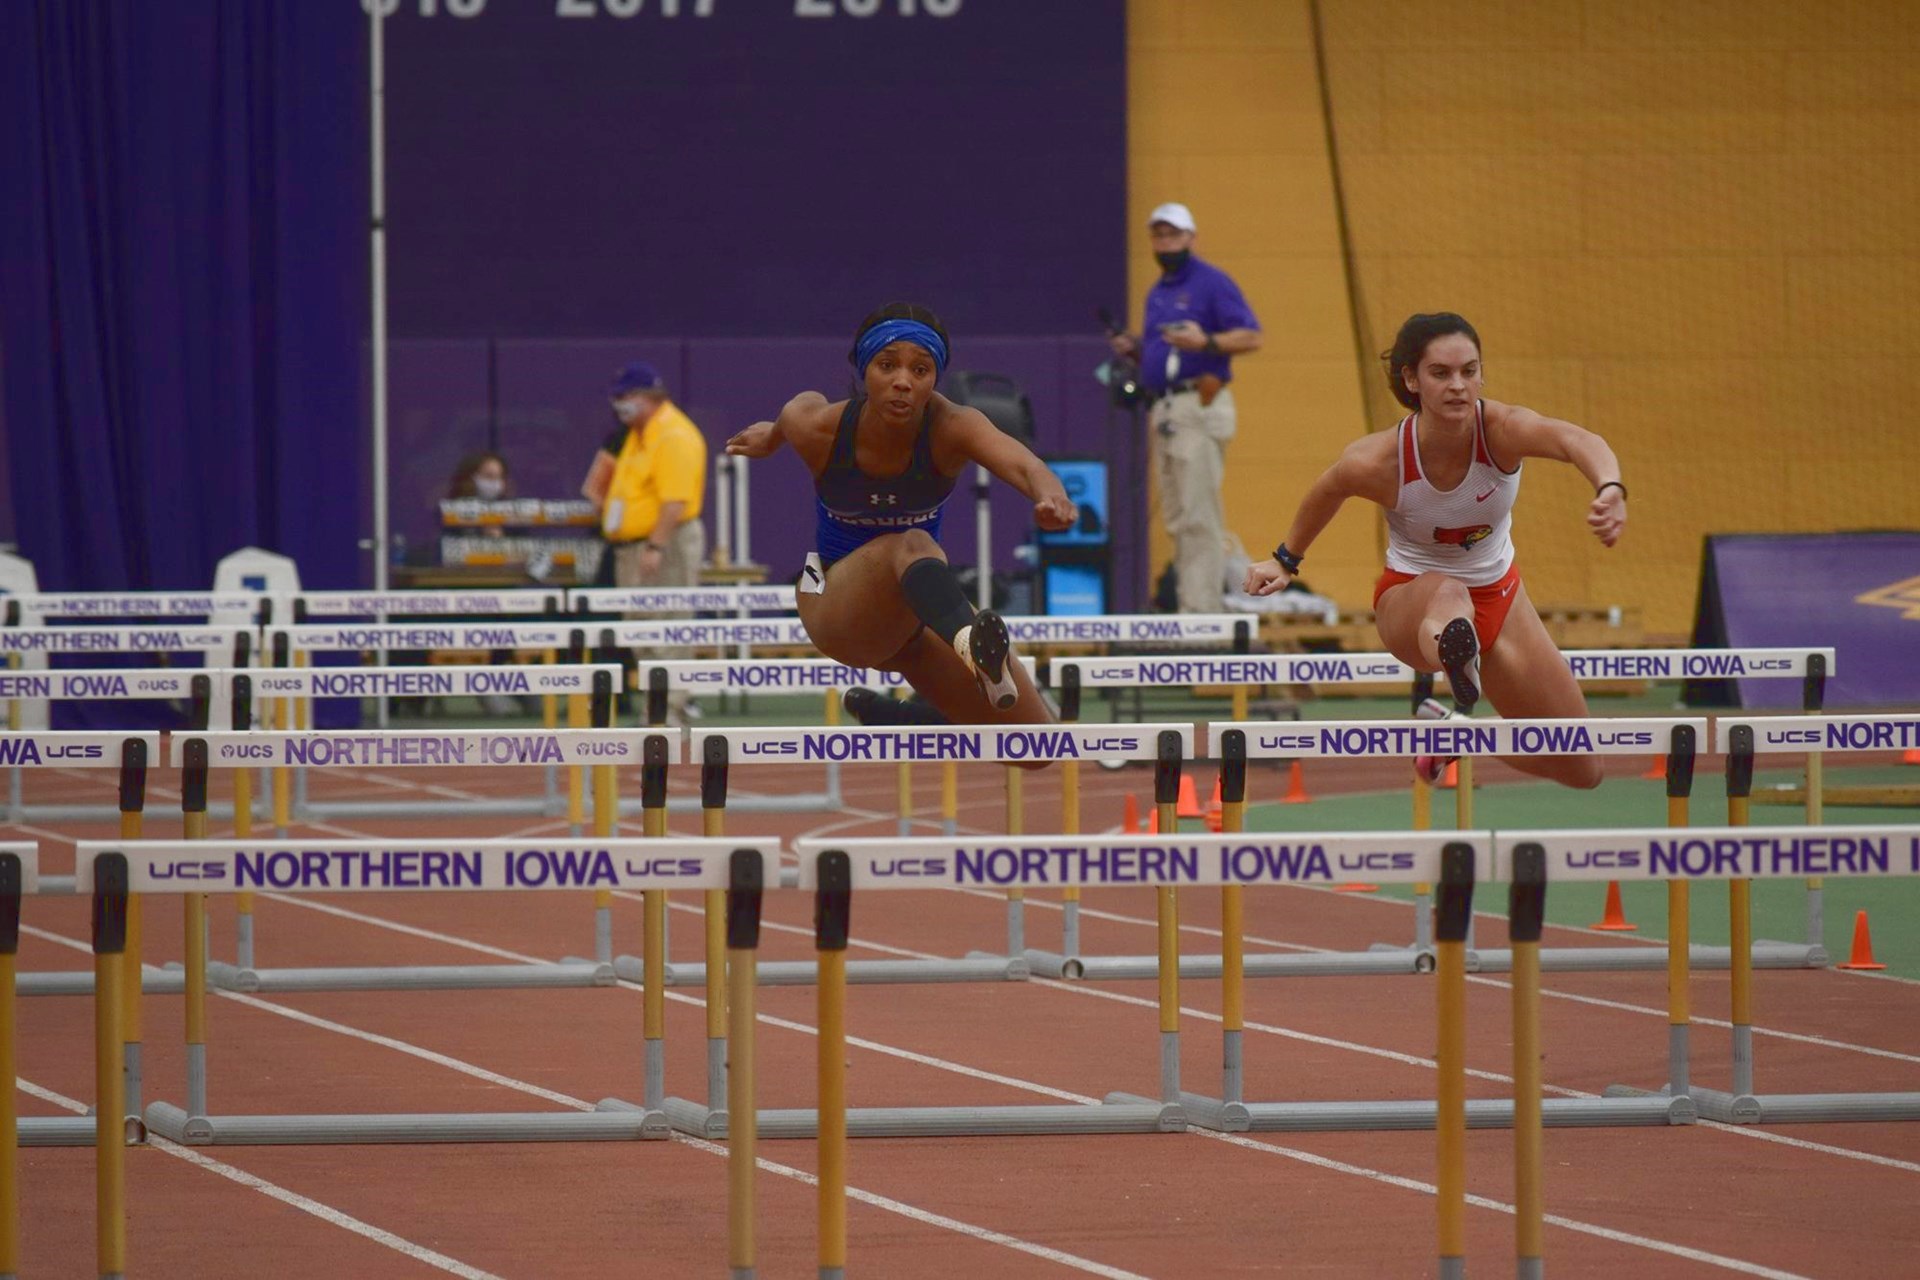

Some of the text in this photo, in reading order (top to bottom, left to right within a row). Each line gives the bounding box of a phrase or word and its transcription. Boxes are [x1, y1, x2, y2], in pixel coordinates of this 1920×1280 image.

[3, 631, 119, 649] NORTHERN
[130, 630, 182, 648] IOWA
[338, 629, 453, 648] NORTHERN
[464, 629, 517, 647] IOWA
[664, 625, 779, 644] NORTHERN
[1007, 621, 1120, 640] NORTHERN
[1131, 620, 1182, 639] IOWA
[680, 671, 723, 683] UCS
[727, 665, 866, 687] NORTHERN
[1091, 660, 1400, 683] UCS NORTHERN IOWA UCS
[1565, 656, 1792, 677] RTHERN IOWA UCS
[63, 675, 128, 697] IOWA
[150, 679, 179, 691] UCS
[274, 672, 580, 695] UCS NORTHERN IOWA UCS
[742, 731, 1138, 760] UCS NORTHERN IOWA UCS
[1260, 726, 1652, 755] UCS NORTHERN IOWA UCS
[1767, 721, 1920, 749] UCS NORT
[46, 745, 103, 758] UCS
[237, 736, 628, 765] UCS NORTHERN IOWA UCS
[870, 845, 1414, 883] UCS NORTHERN IOWA UCS
[1566, 850, 1640, 868] UCS
[1649, 837, 1888, 876] NORTHERN
[149, 849, 703, 888] UCS NORTHERN IOWA UCS
